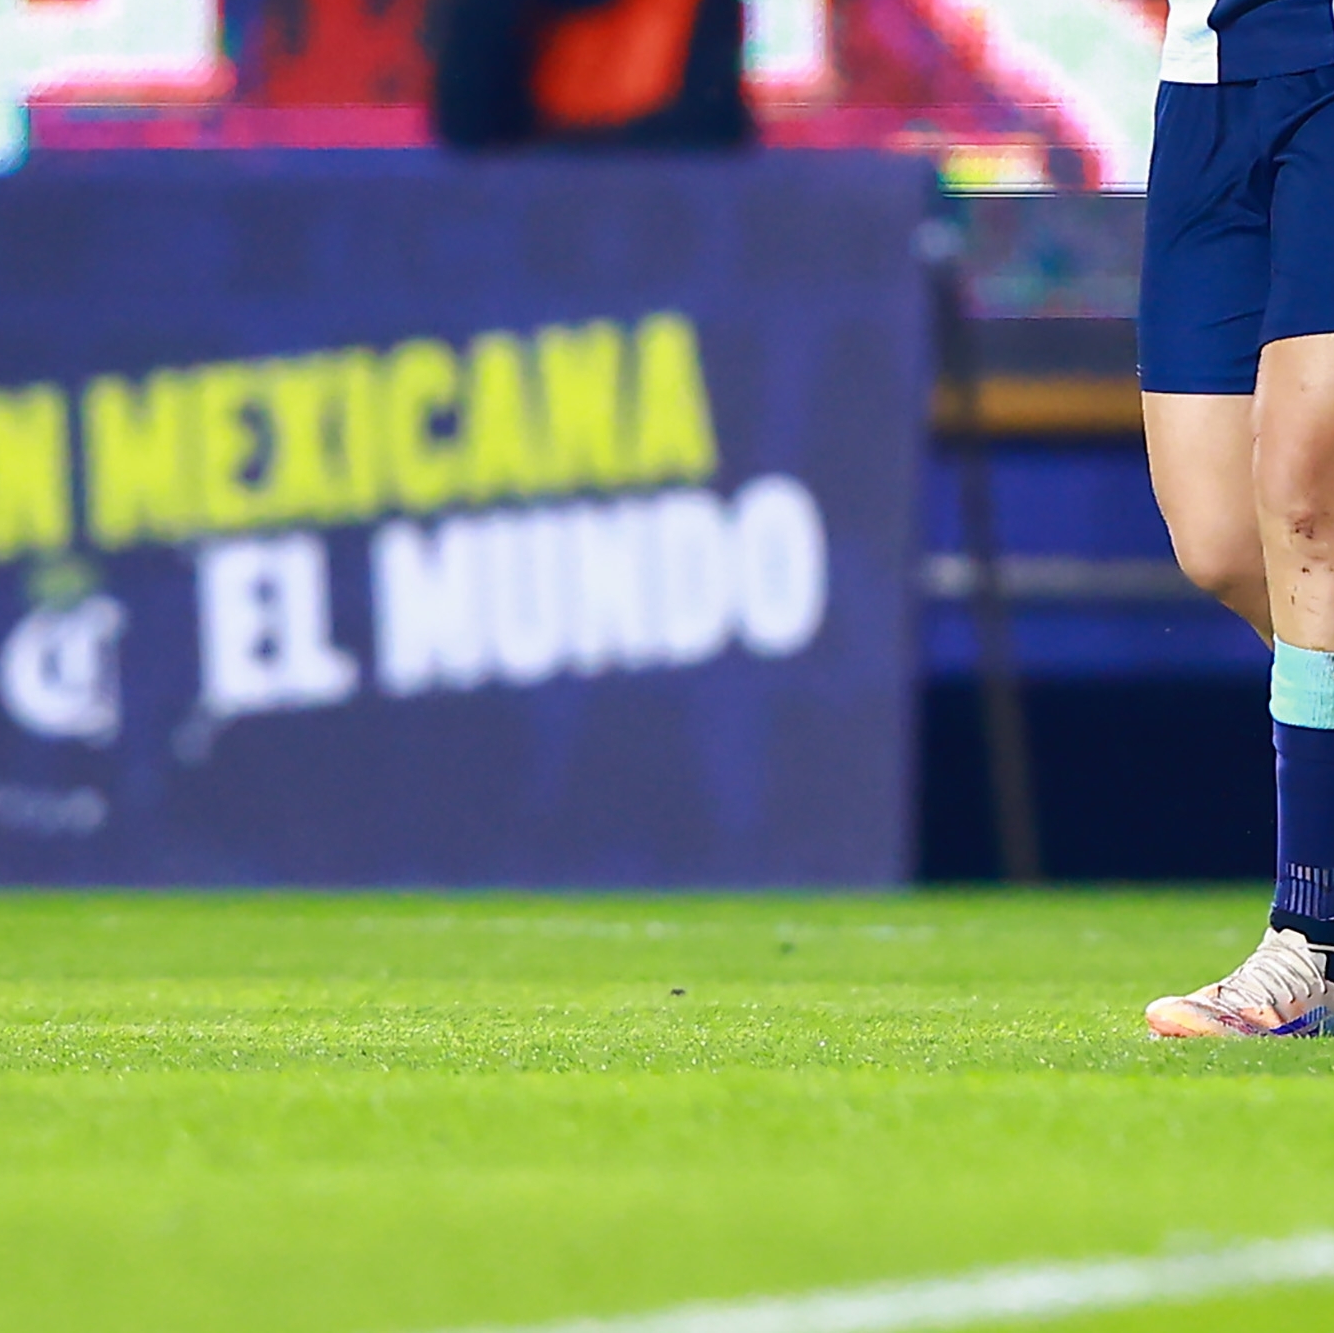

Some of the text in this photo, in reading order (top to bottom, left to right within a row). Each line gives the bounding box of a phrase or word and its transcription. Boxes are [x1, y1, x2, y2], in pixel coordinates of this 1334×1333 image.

[82, 312, 718, 549] MEXICANA
[198, 533, 359, 717] EL
[370, 474, 828, 696] MUNDO
